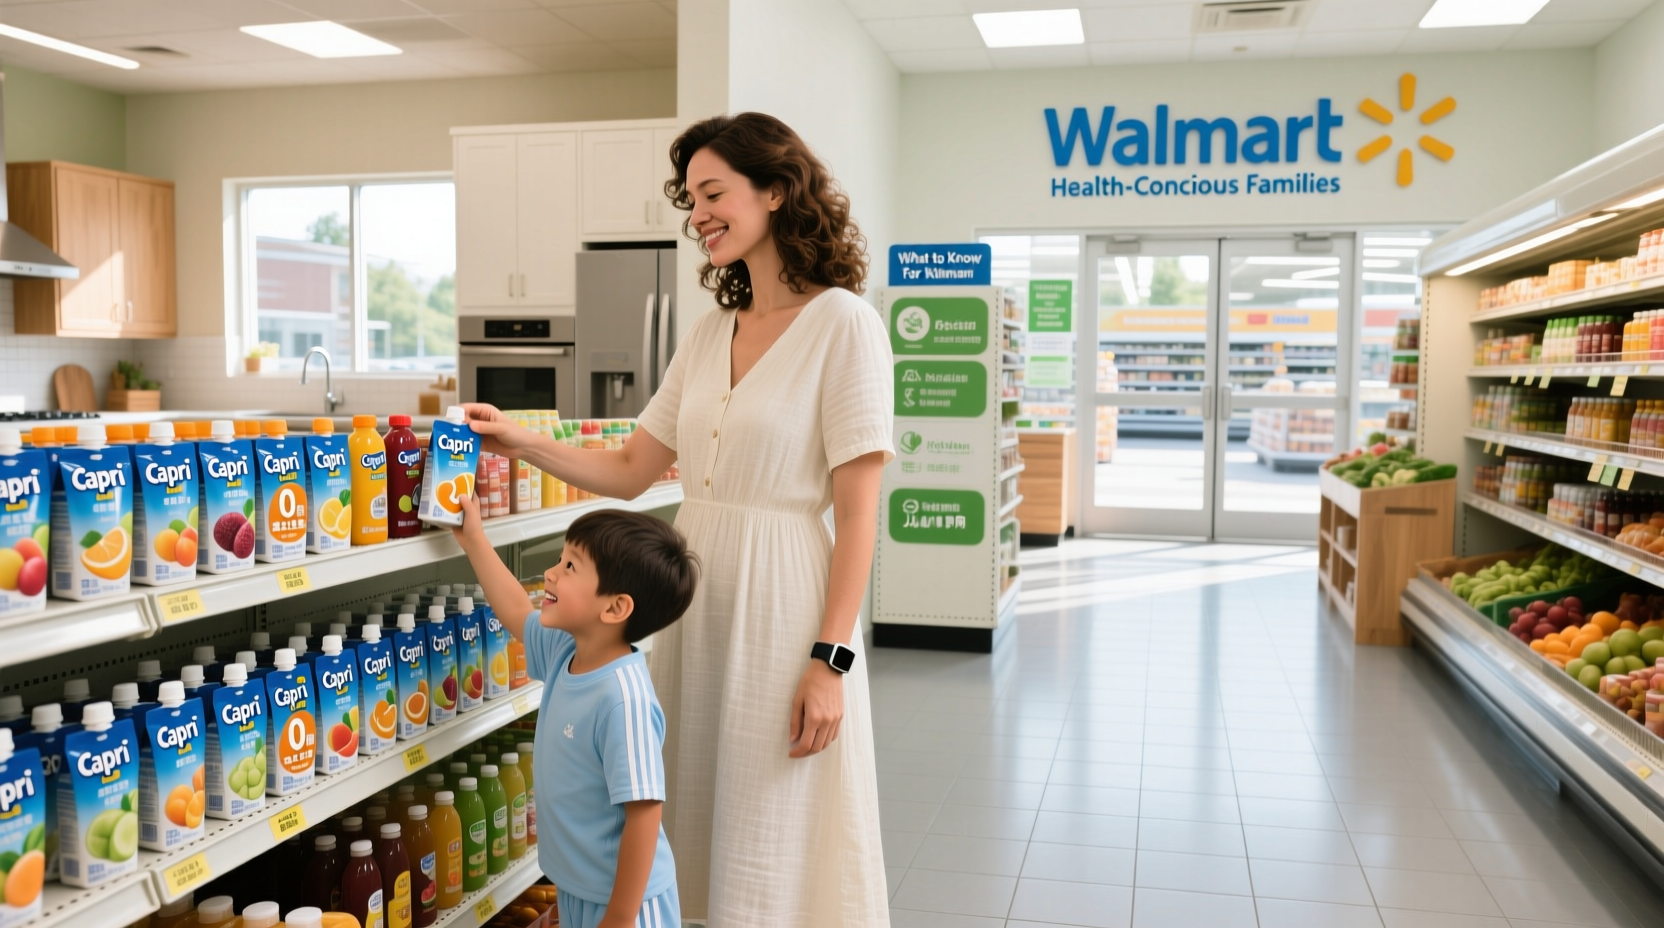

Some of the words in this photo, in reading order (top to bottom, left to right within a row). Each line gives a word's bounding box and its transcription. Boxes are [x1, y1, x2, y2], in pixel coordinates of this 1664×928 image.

[1044, 98, 1343, 167] Walmart
[1051, 174, 1239, 198] Health-Concious
[1246, 173, 1341, 195] Families
[898, 251, 929, 264] What
[932, 252, 945, 264] to
[947, 251, 982, 264] Know
[71, 462, 126, 493] Capri
[145, 458, 191, 485] Capri
[208, 455, 248, 481] Capri
[264, 451, 300, 475] Capri
[0, 468, 41, 503] apri
[279, 488, 296, 518] 0
[322, 664, 353, 690] Capri
[222, 695, 261, 724] Capri
[274, 682, 308, 711] Capri
[157, 715, 199, 748] Capri
[288, 718, 306, 751] 0
[78, 739, 130, 776] Capri
[0, 769, 35, 812] pri
